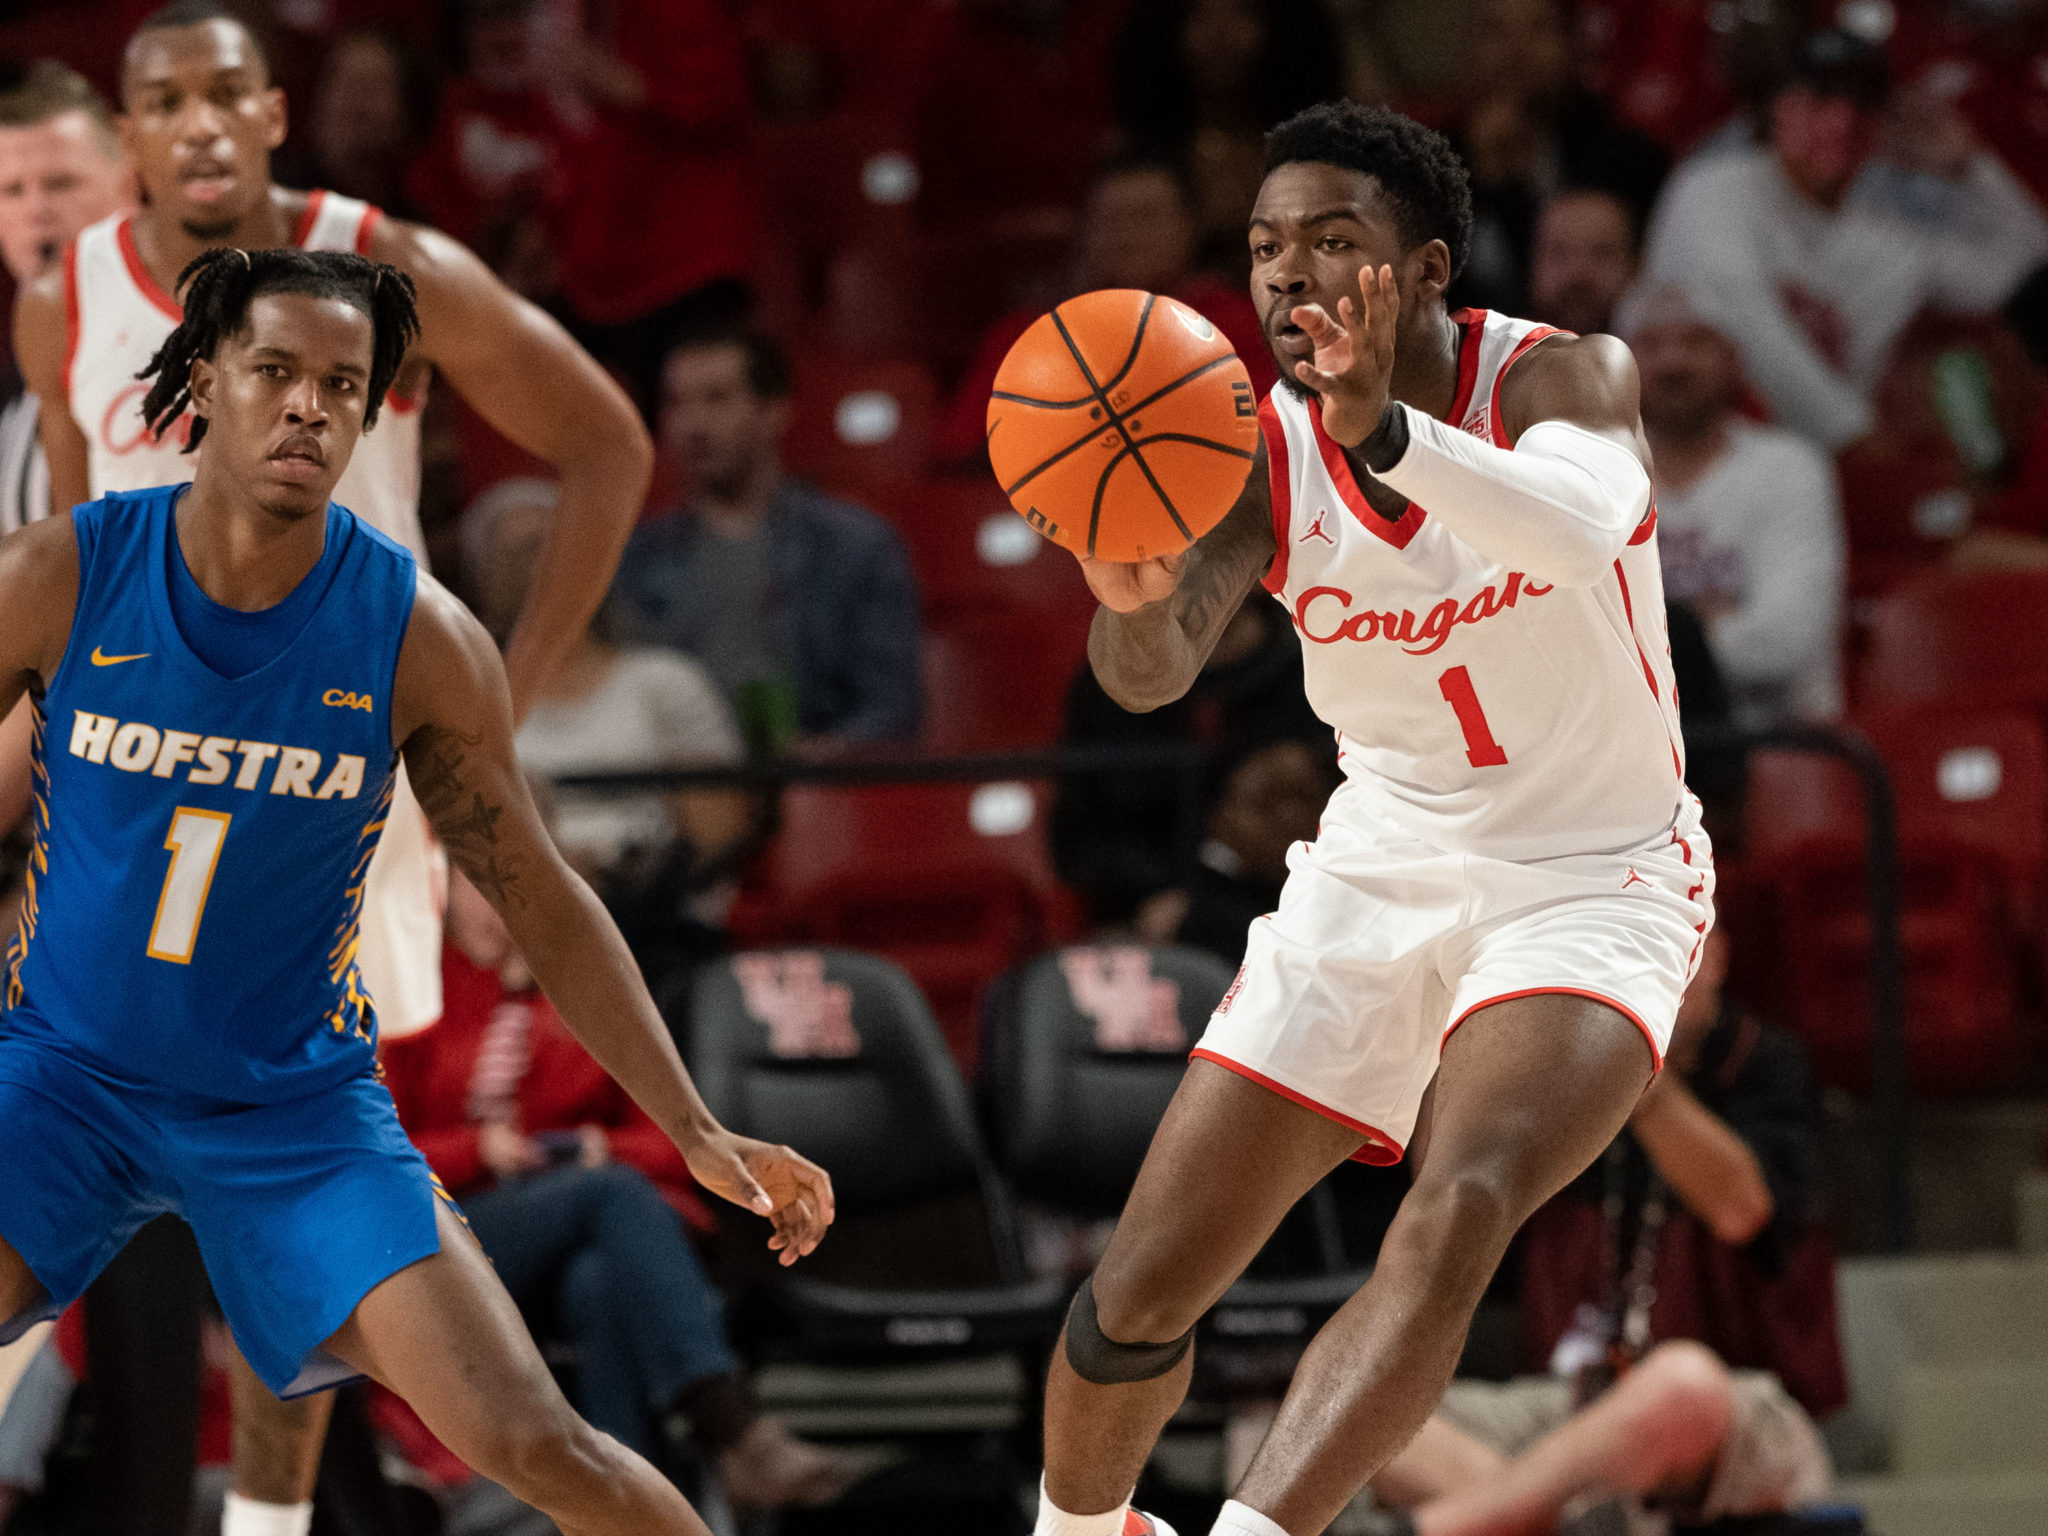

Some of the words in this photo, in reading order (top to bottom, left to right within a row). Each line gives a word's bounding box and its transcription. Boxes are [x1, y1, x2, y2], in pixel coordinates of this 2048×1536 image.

[322, 688, 373, 713] CAA
[1438, 665, 1509, 768] 1
[69, 709, 367, 800] HOFSTRA
[146, 806, 233, 965] 1
